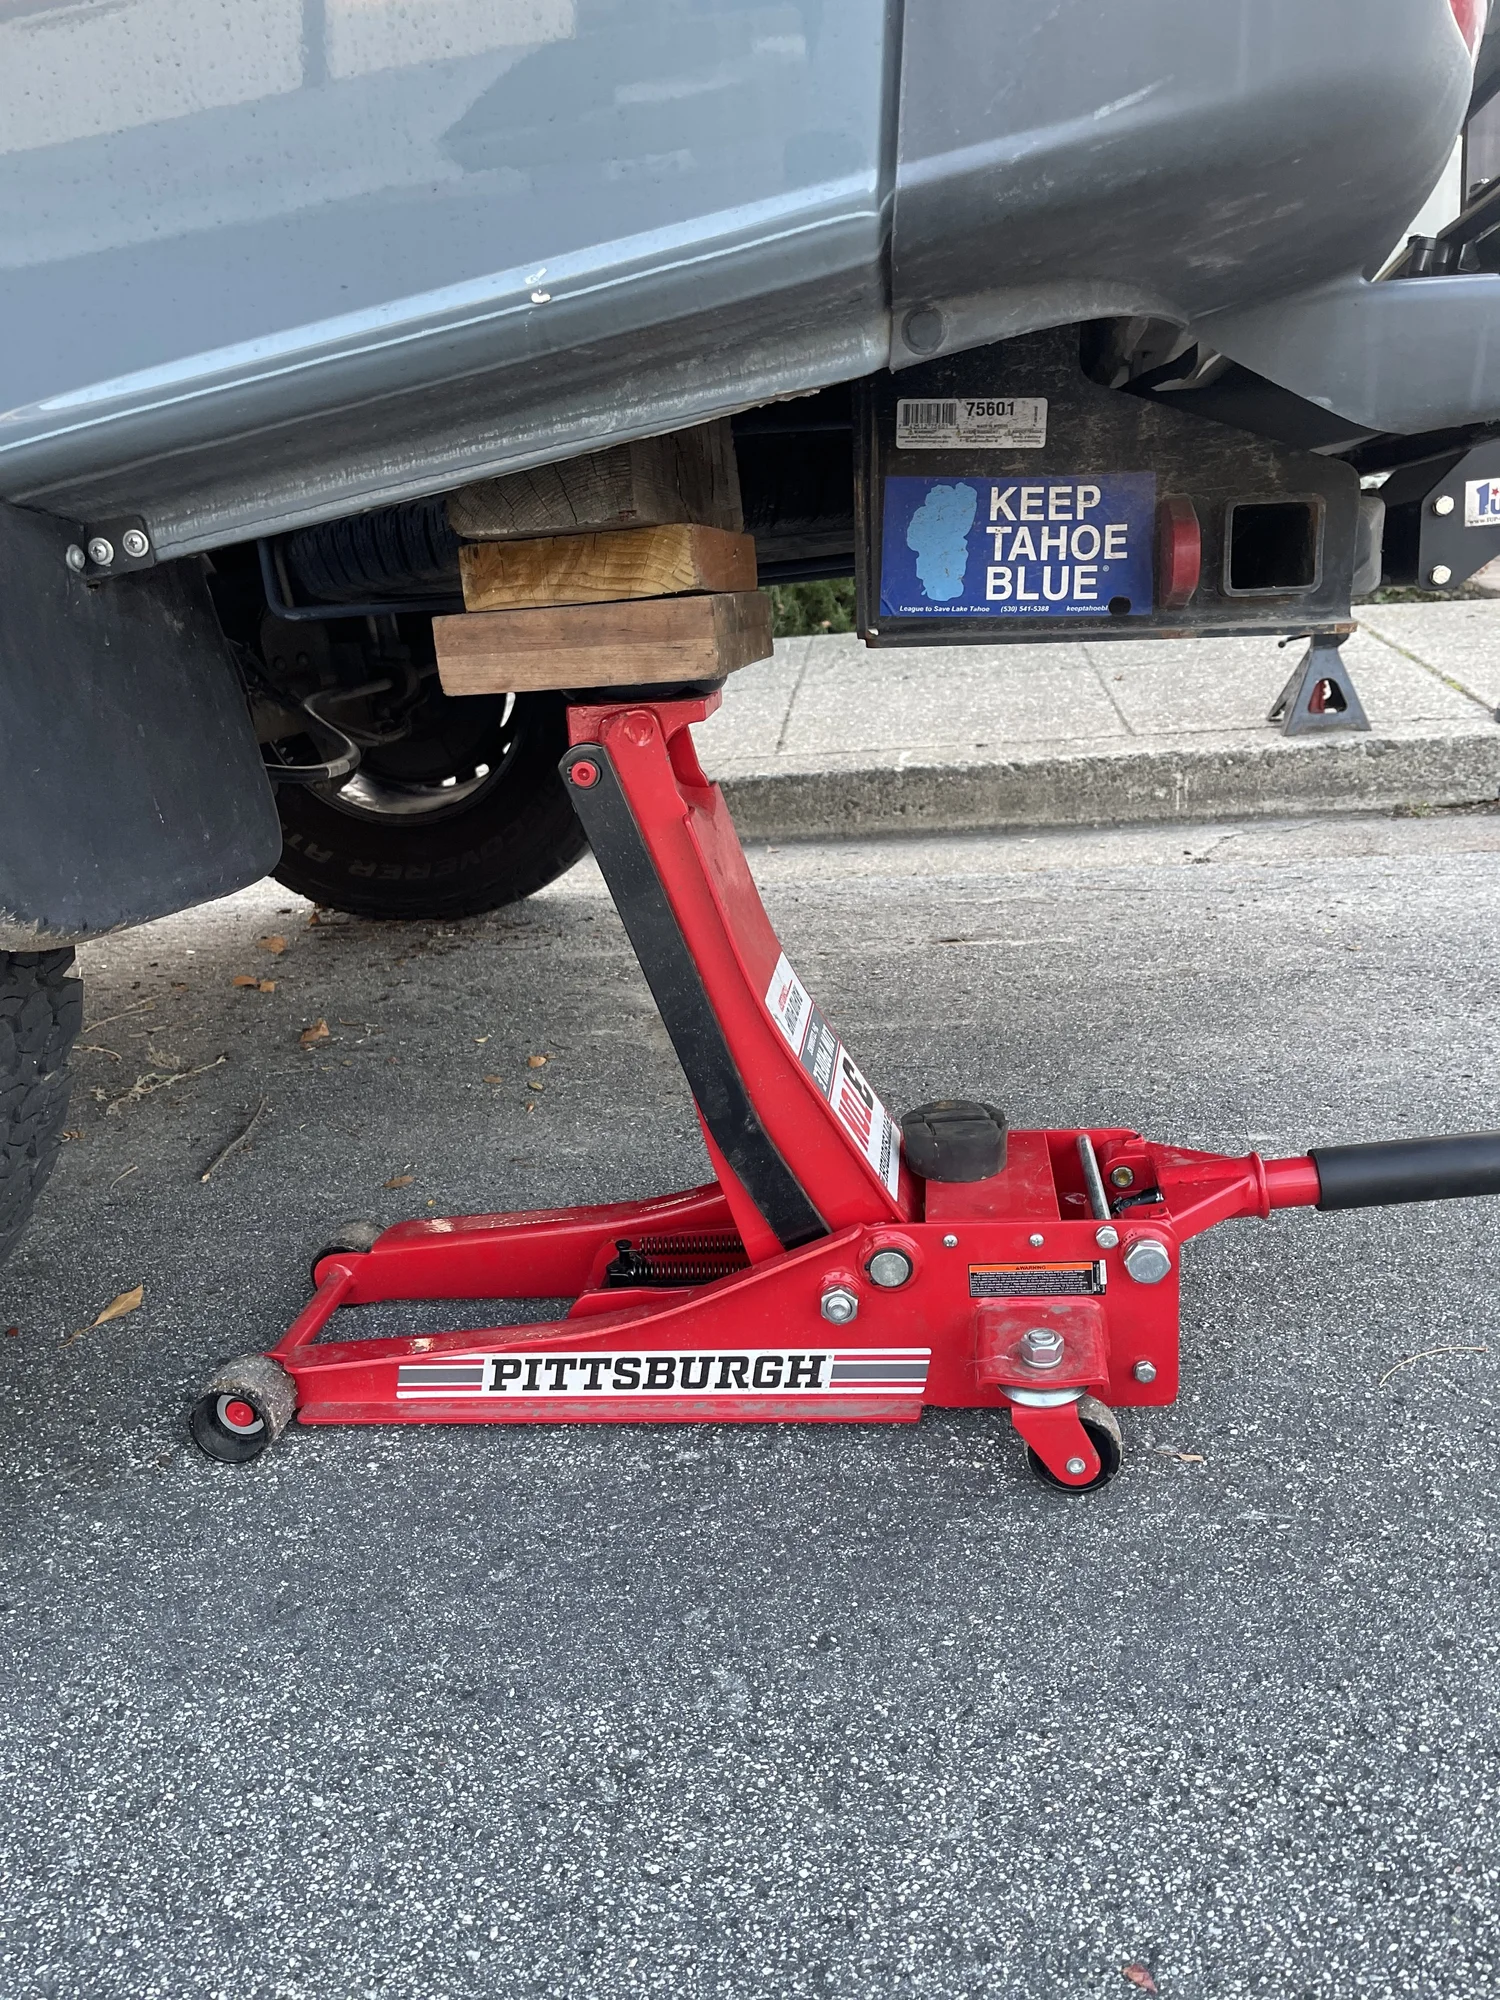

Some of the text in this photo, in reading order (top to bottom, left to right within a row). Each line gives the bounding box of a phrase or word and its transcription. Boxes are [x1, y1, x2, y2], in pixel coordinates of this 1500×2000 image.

[966, 402, 1015, 416] 75601
[989, 485, 1101, 521] KEEP
[986, 524, 1128, 562] TAHOE
[986, 565, 1098, 601] BLUE
[899, 605, 924, 614] League
[1000, 605, 1018, 613] (530)
[820, 1024, 836, 1057] LOW
[813, 1042, 832, 1092] PROFILE
[839, 1056, 873, 1152] 3 TON
[879, 1114, 892, 1182] PITTSBURGH
[488, 1355, 826, 1392] PITTSBURGH
